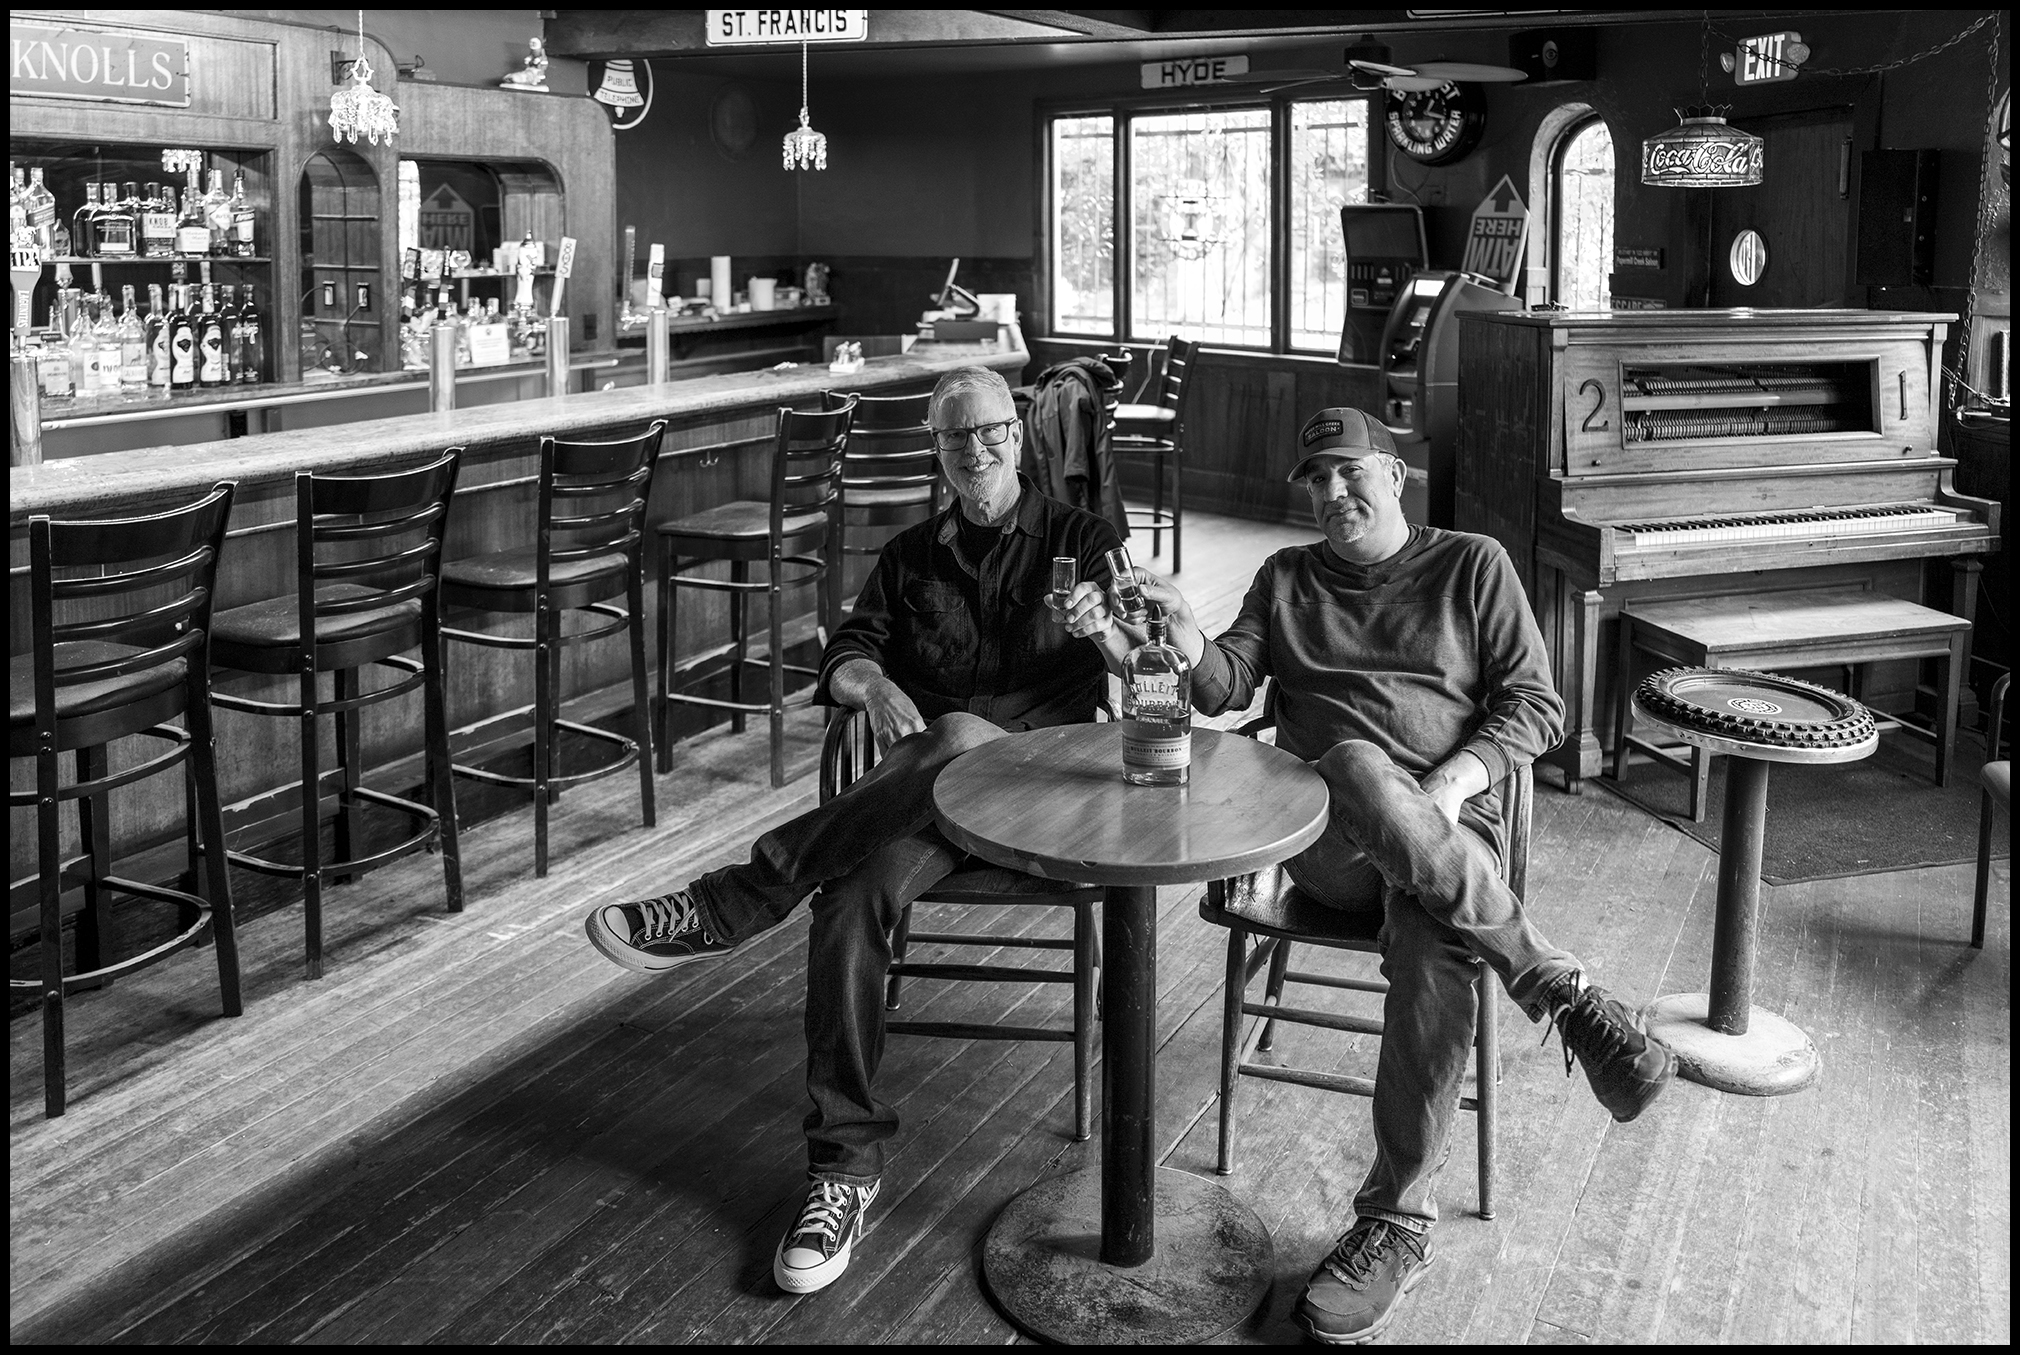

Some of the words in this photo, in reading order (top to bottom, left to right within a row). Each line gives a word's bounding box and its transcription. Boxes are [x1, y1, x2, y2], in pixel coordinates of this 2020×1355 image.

[722, 12, 751, 36] ST.
[758, 10, 847, 36] FRANCIS
[12, 39, 173, 90] KNOLLS
[1744, 34, 1785, 81] EXIT
[607, 75, 633, 87] PUBLIC
[1161, 61, 1226, 84] HYDE
[600, 90, 641, 105] TELEPHONE
[1388, 111, 1433, 155] SPARKLING
[1434, 109, 1462, 151] WATER
[149, 217, 169, 226] KNOB
[1475, 218, 1522, 236] HERE
[10, 251, 41, 267] IPA
[1467, 237, 1520, 278] ATM
[1579, 379, 1609, 432] 2
[1898, 370, 1909, 420] 1
[1307, 426, 1337, 440] SALOON
